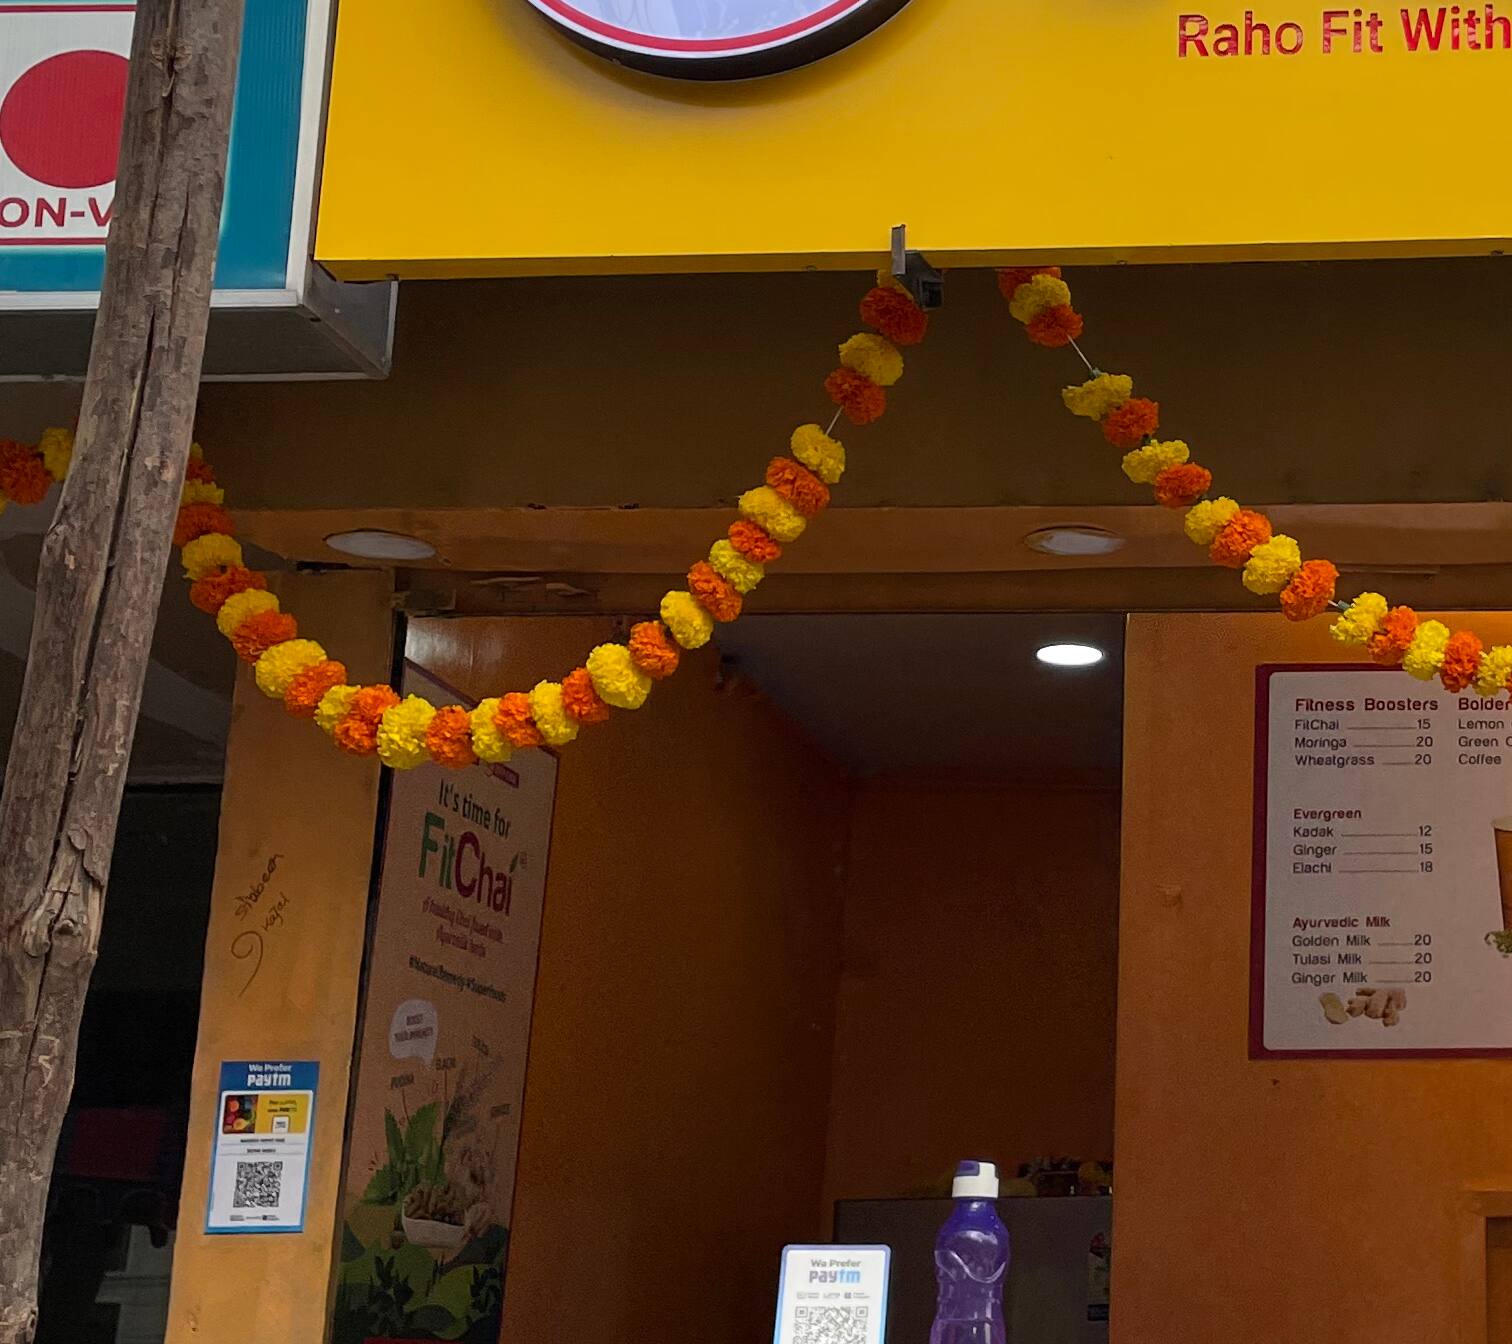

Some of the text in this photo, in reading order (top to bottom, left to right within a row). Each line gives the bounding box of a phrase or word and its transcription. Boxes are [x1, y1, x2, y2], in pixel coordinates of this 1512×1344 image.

[1177, 10, 1303, 57] Raho
[1322, 8, 1383, 54] Fit
[1400, 3, 1511, 52] With
[0, 197, 112, 227] ON-V
[1294, 697, 1438, 712] Fitness Boosters
[1294, 719, 1431, 731] FitChai 15
[1458, 719, 1505, 730] Lemon
[1294, 736, 1433, 750] Moringa 20
[1458, 736, 1499, 748] Green
[1294, 754, 1432, 768] Wheatgrass 20
[1458, 754, 1502, 765] Coffee
[462, 794, 491, 830] time
[1293, 809, 1362, 822] Evergreen
[1293, 826, 1432, 838] Kadak 12
[1293, 844, 1433, 858] Ginger 15
[1293, 861, 1433, 874] Elachi 18
[1366, 916, 1391, 928] Milk
[1292, 934, 1431, 946] Golden Milk 20
[1292, 953, 1432, 965] Tulasi Milk 20
[1292, 971, 1432, 986] Ginger Milk 20
[829, 1259, 861, 1268] Prefer
